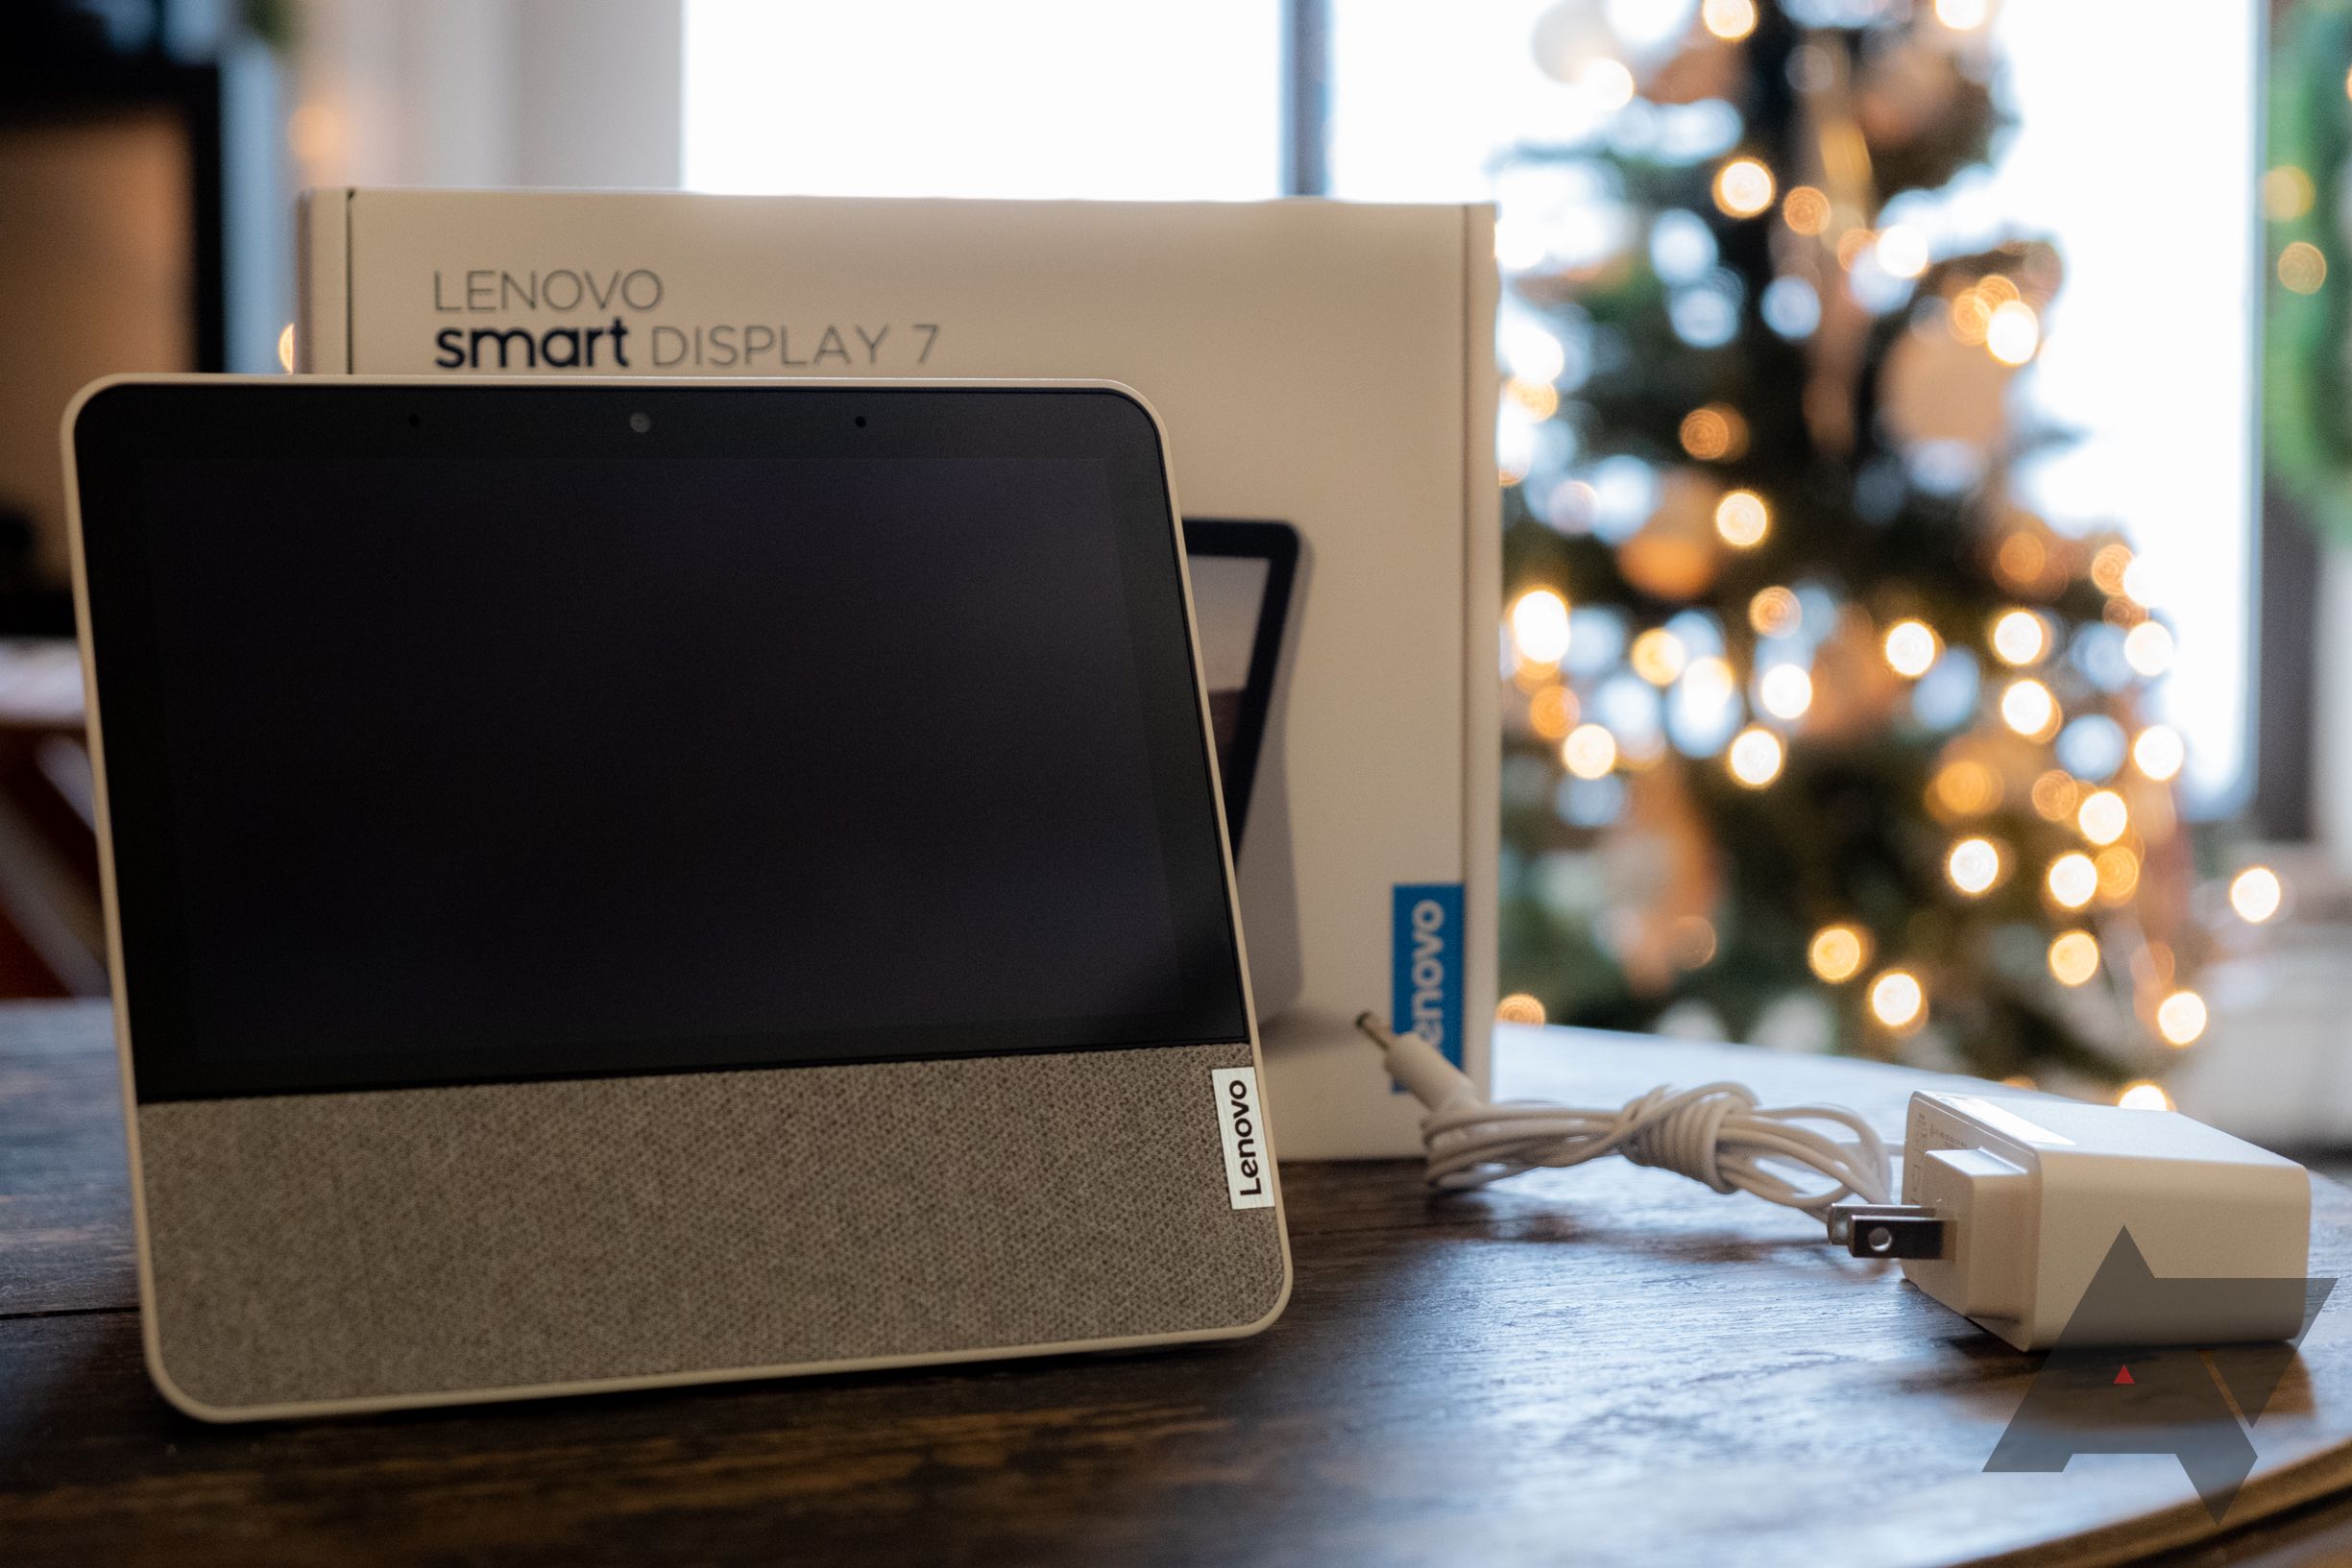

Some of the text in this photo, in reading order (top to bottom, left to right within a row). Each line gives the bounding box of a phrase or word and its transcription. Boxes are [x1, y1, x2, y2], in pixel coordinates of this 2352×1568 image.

[433, 269, 664, 312] LENOVO
[435, 317, 940, 369] smart DISPLAY 7
[1411, 899, 1444, 1047] enovo
[1229, 1080, 1262, 1195] Lenovo
